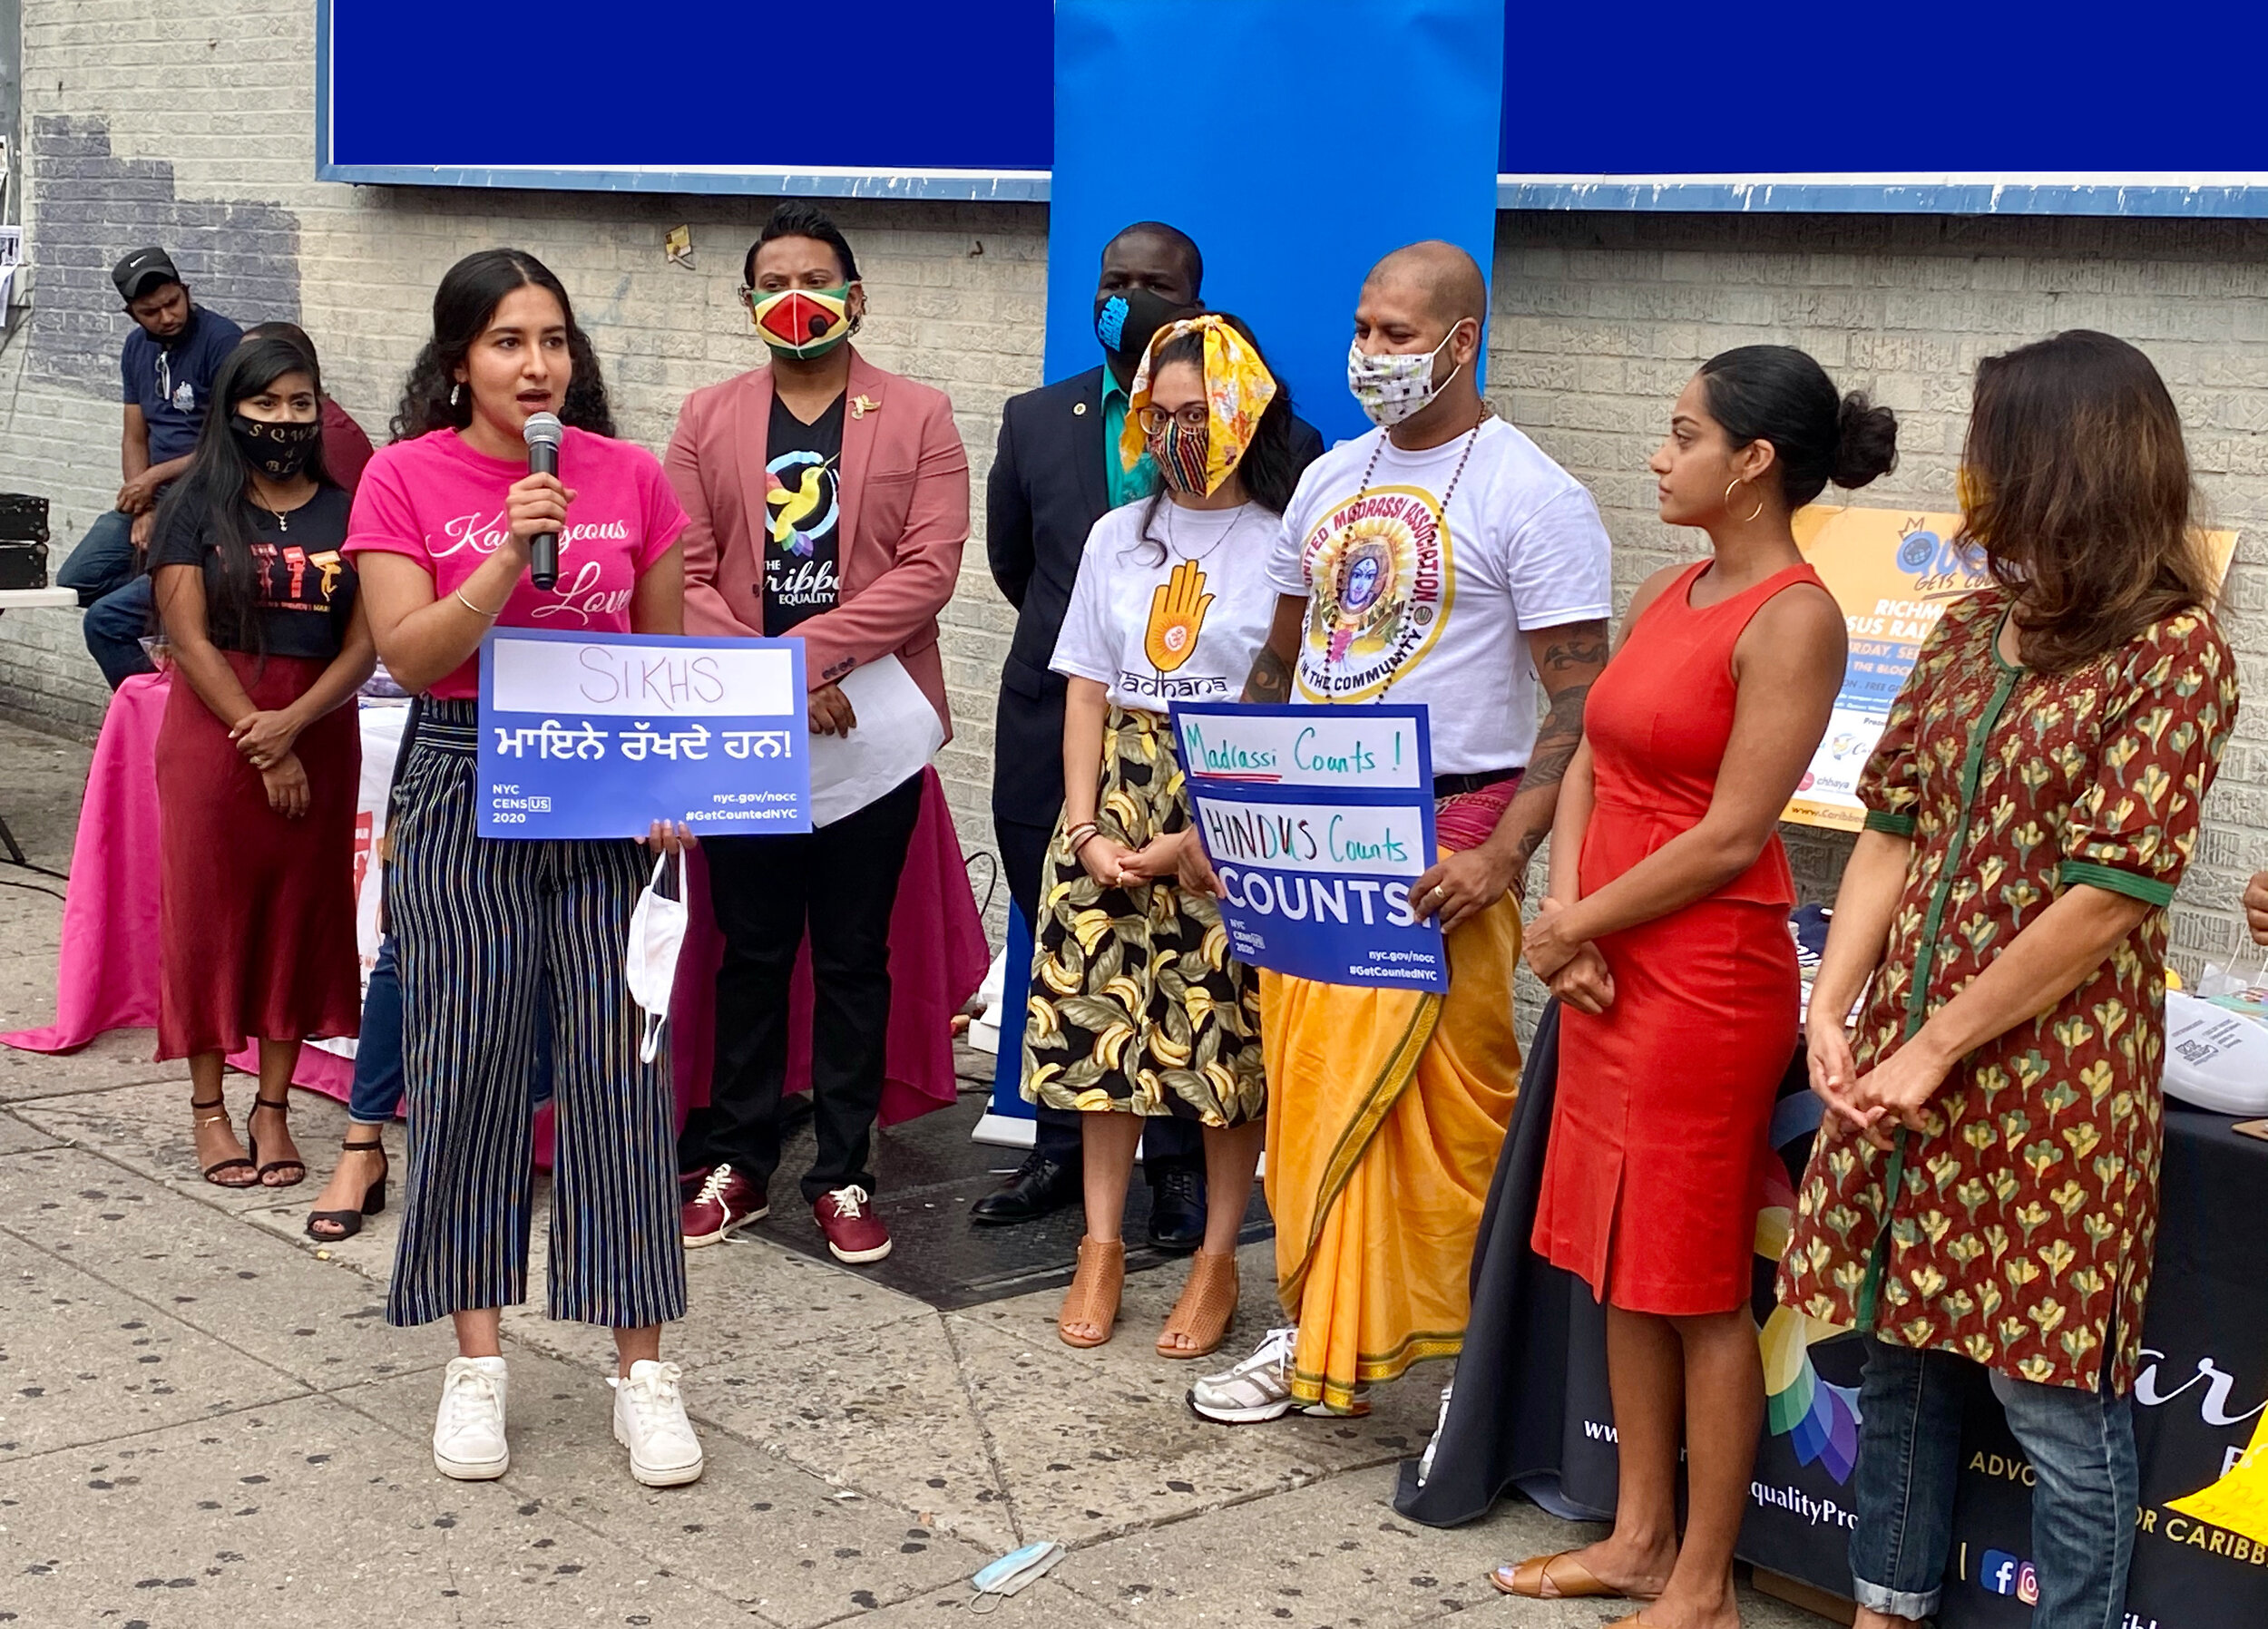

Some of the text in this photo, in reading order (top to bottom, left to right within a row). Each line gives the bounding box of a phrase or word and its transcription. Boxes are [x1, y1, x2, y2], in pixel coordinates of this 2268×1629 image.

[1303, 527, 1330, 588] UNITED
[1334, 497, 1409, 532] MADRASSI
[1914, 572, 1957, 591] GETS
[531, 561, 633, 626] Love
[778, 592, 836, 605] EQUALITY
[1873, 599, 1947, 621] RICHM
[1844, 616, 1885, 636] SUS
[1853, 661, 1873, 673] THE
[579, 647, 724, 711] SIKHS
[1116, 669, 1228, 698] adhana
[1309, 670, 1332, 690] THE
[494, 718, 792, 762] ਮਾਇਨੇ ਰੱਖਦੇ ਹਨ!
[1185, 723, 1277, 772] Madrassi
[1295, 727, 1376, 774] Counts
[493, 784, 520, 796] NYC
[712, 791, 798, 805] nyc.gov/nocc
[493, 812, 527, 824] 2020
[685, 808, 798, 823] #GetCountedNYC
[1206, 807, 1409, 863] HINDUS Counts
[1217, 866, 1432, 929] COUNTS
[1368, 950, 1436, 964] nyc.gov/nocc
[1349, 964, 1438, 981] #GetCountedNYC
[2165, 1517, 2268, 1568] CARIBB
